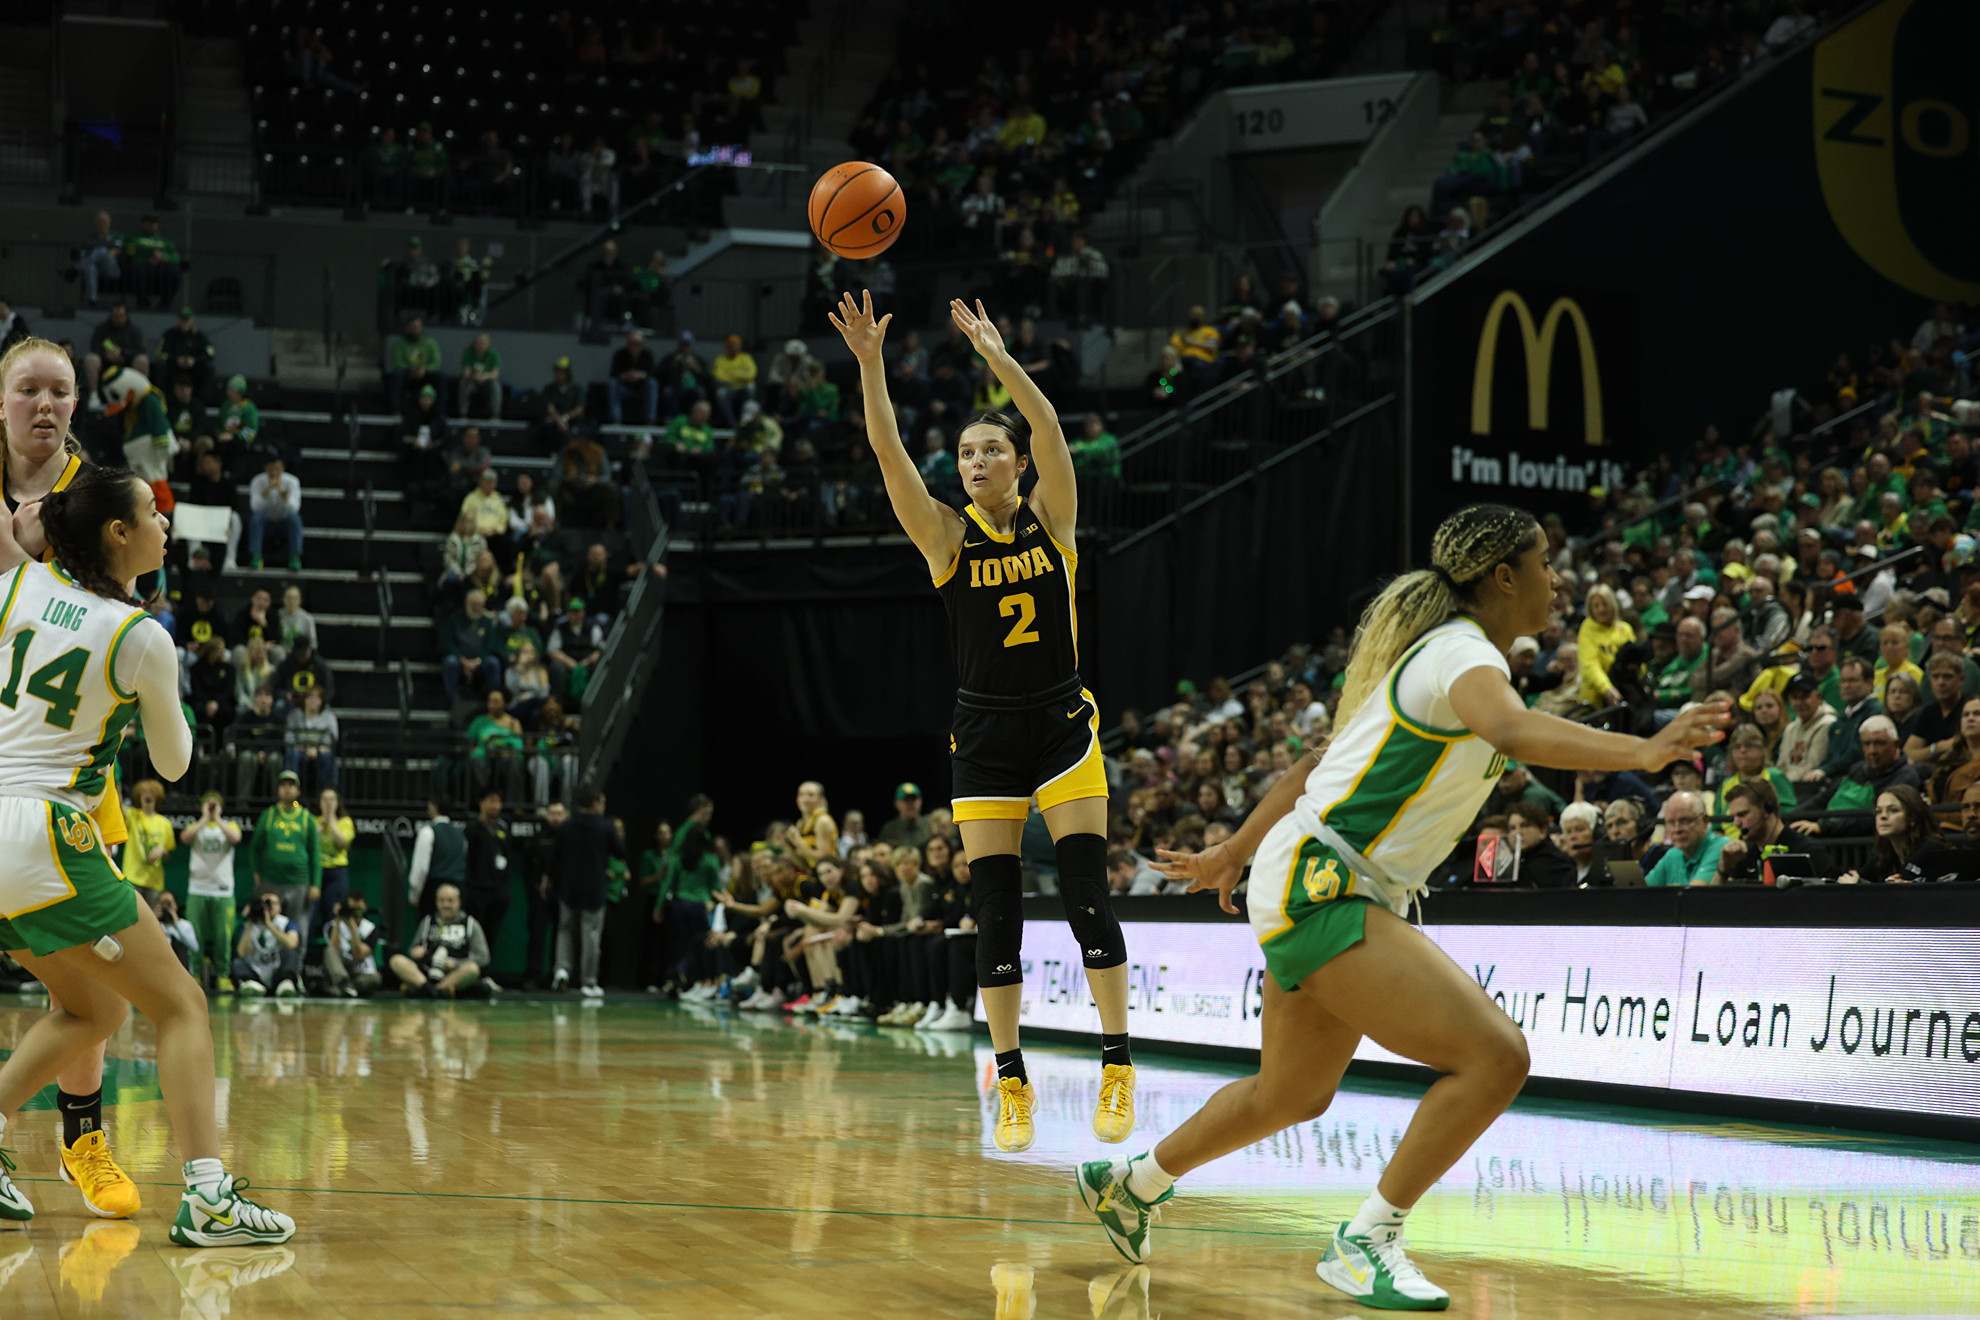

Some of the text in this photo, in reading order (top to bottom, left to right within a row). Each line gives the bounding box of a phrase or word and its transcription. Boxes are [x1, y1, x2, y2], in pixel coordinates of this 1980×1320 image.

[1235, 108, 1285, 136] 120
[1821, 87, 1980, 160] ZO
[1451, 444, 1502, 484] i'm
[1507, 451, 1596, 493] lovin'
[969, 545, 1055, 588] IOWA
[41, 597, 88, 632] LONG
[998, 591, 1040, 648] 2
[0, 627, 92, 732] 14
[1561, 966, 1670, 1042] Home
[1691, 971, 1790, 1048] Loan
[1811, 974, 1980, 1064] Journe
